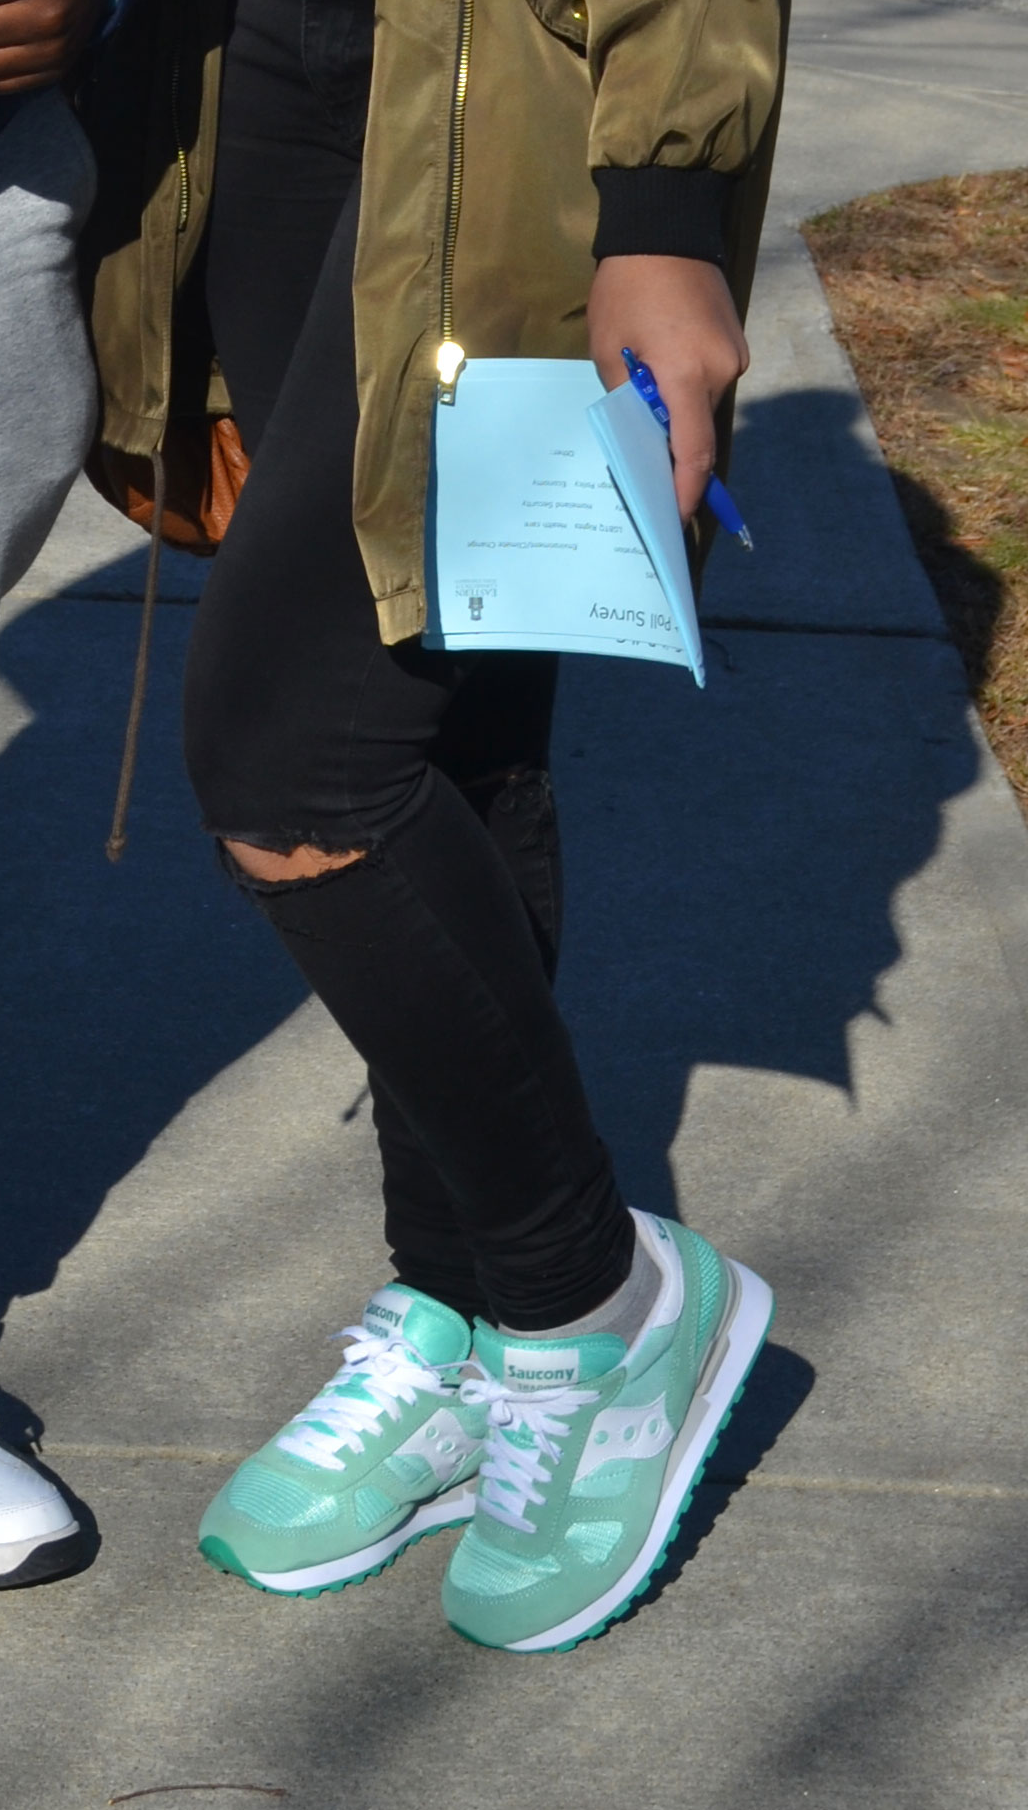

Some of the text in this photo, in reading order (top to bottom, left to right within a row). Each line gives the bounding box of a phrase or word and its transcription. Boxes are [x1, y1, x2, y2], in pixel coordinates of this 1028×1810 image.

[533, 479, 567, 488] Economy
[522, 499, 554, 509] Security
[589, 603, 671, 631] Poll Survey
[508, 1365, 575, 1382] Saucony
